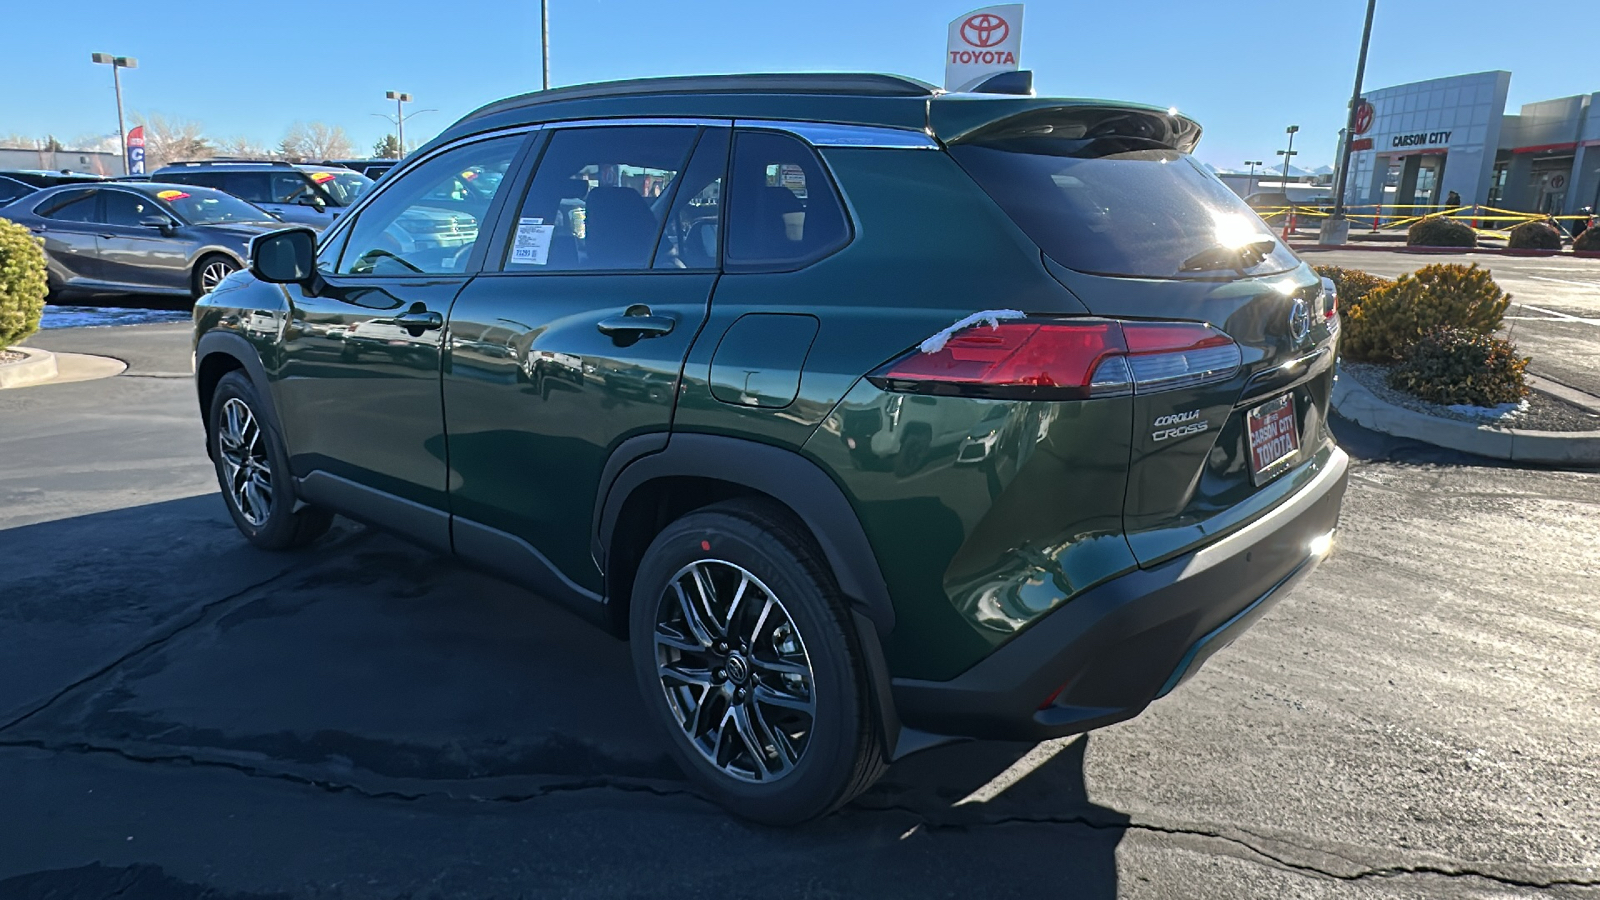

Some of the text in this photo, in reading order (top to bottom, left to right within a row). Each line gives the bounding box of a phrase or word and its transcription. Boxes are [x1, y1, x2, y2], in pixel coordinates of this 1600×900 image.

[950, 51, 1015, 64] TOYOTA
[1392, 131, 1452, 147] CARSON CITY
[1154, 409, 1200, 426] COROLLA
[1152, 420, 1208, 441] CROSS
[1251, 422, 1278, 447] CARSON
[1279, 415, 1293, 433] CITY
[1257, 432, 1292, 467] TOYOTA
